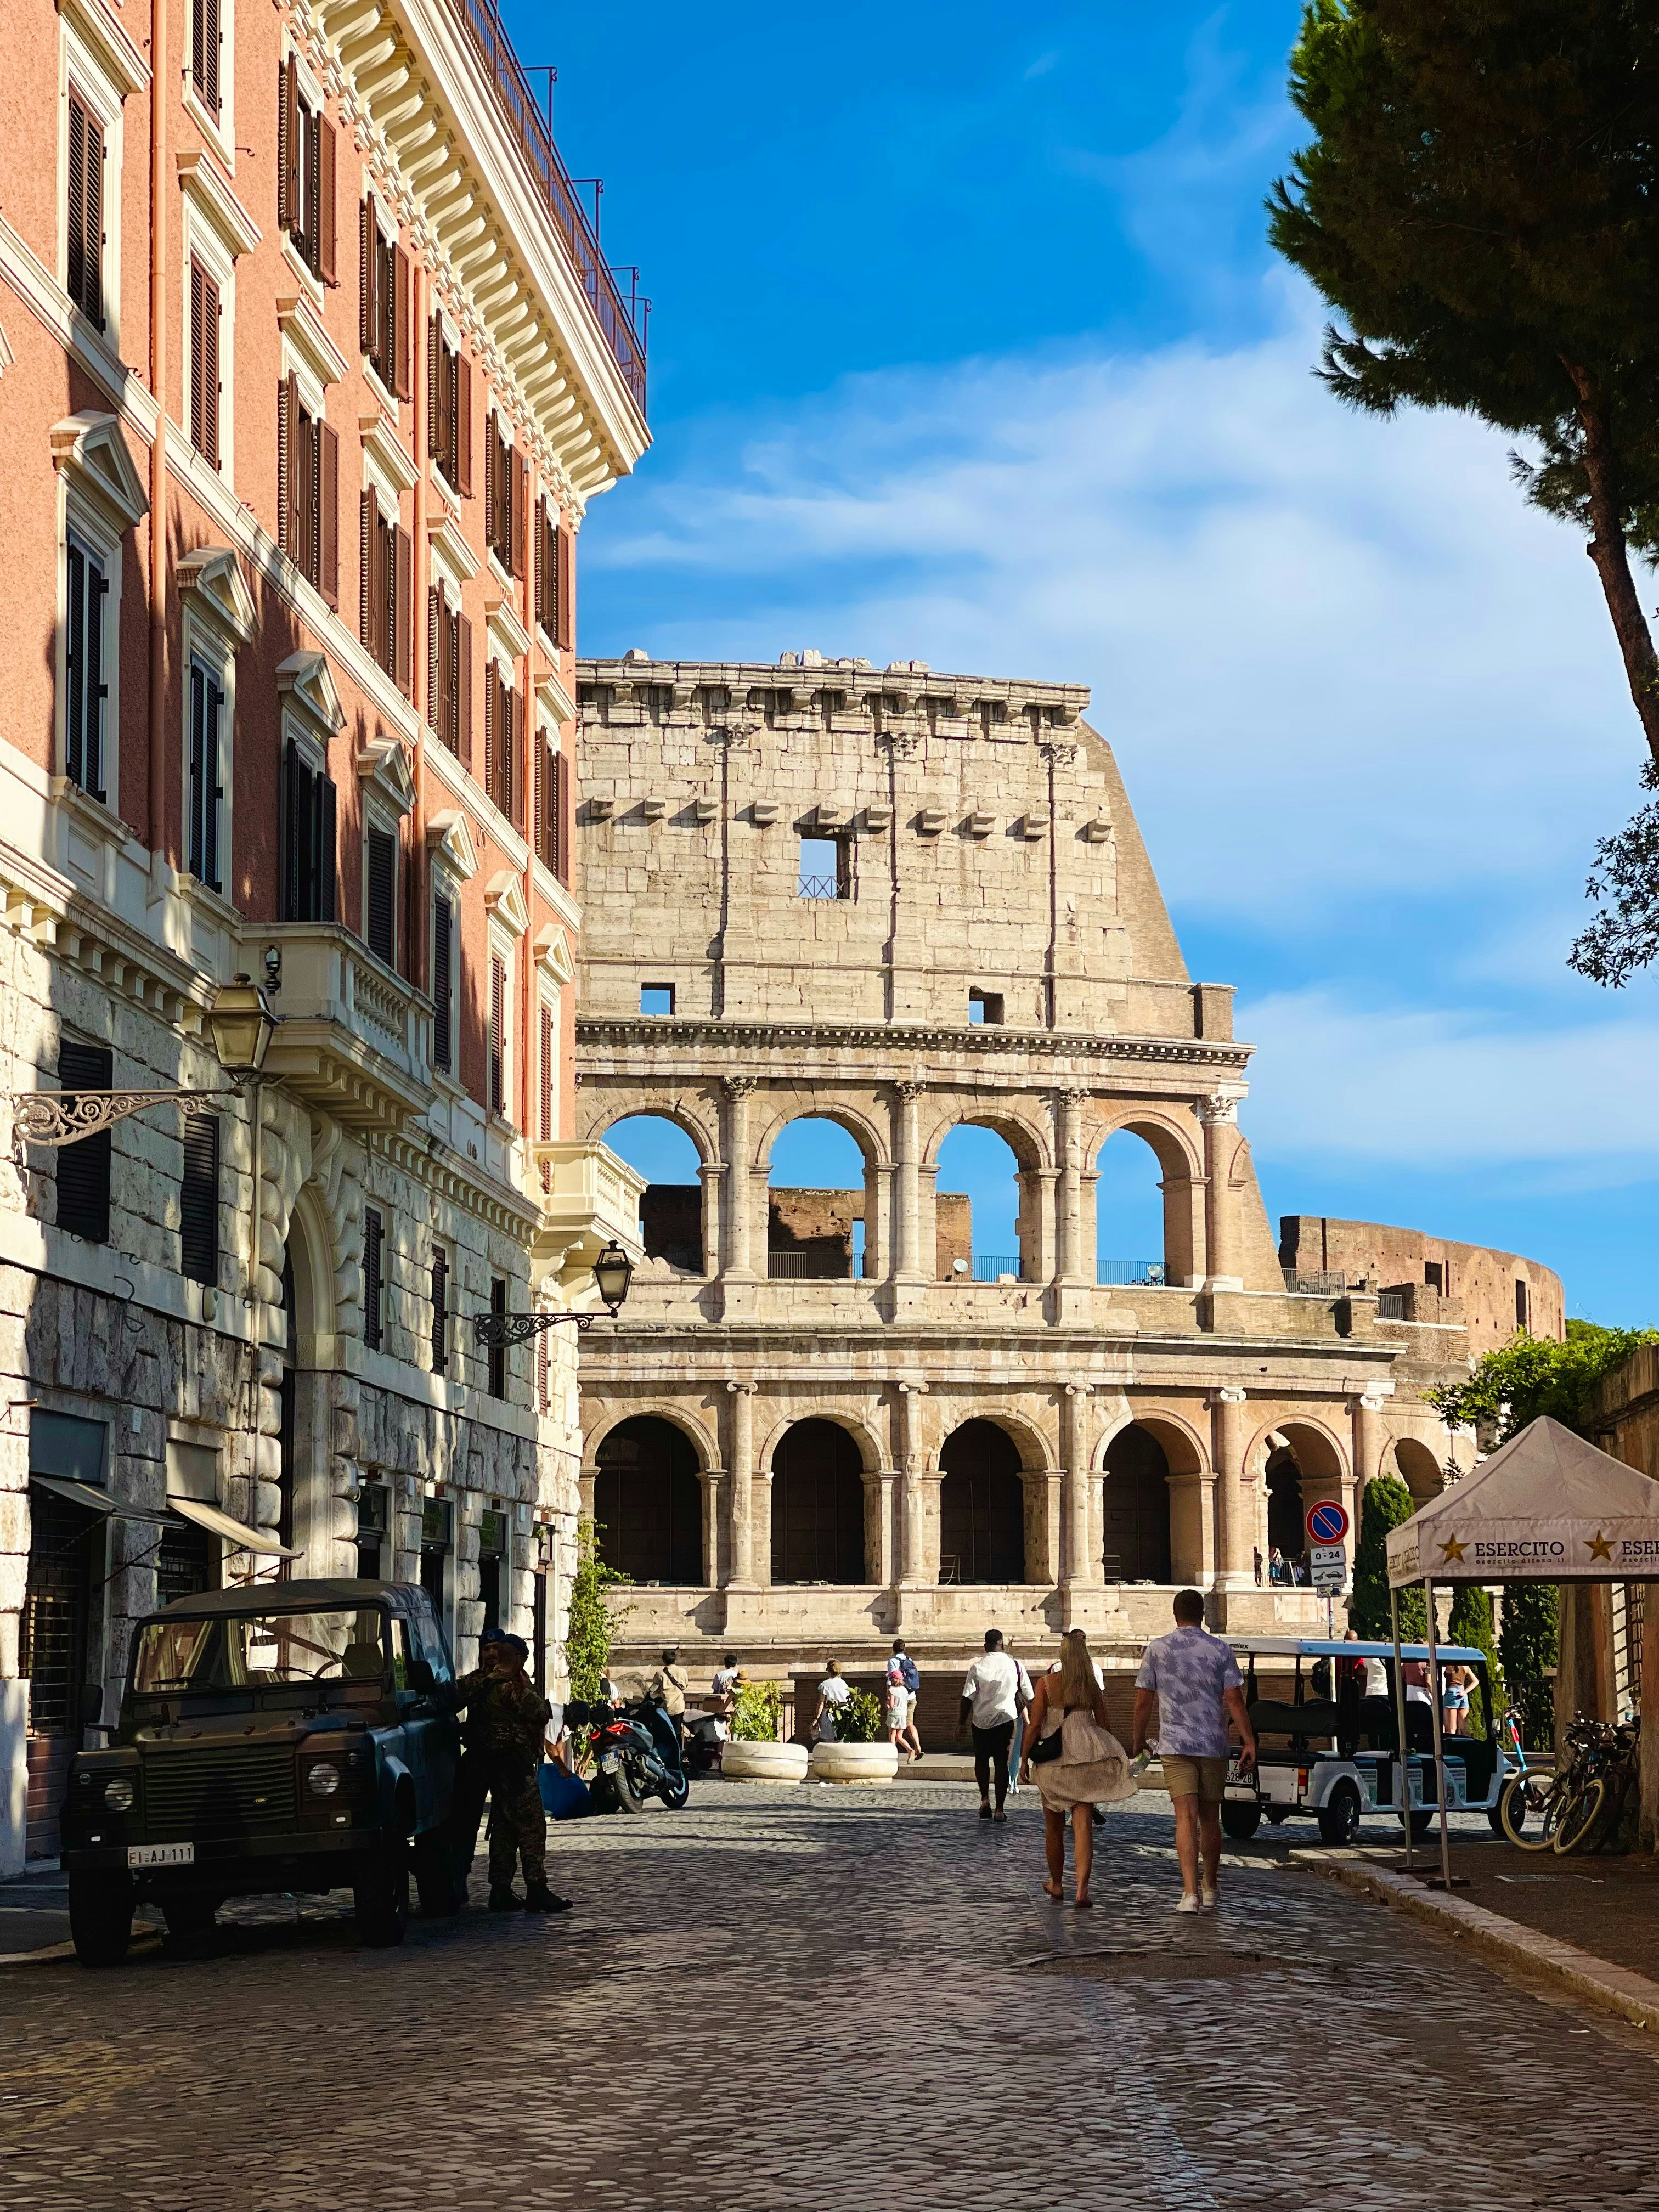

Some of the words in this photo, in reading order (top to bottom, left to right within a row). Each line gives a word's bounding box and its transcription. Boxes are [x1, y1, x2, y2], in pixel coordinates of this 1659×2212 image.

[1475, 1541, 1564, 1556] ESERCITO
[129, 1852, 142, 1864] EI
[151, 1850, 165, 1863] AJ
[172, 1848, 190, 1861] 111
